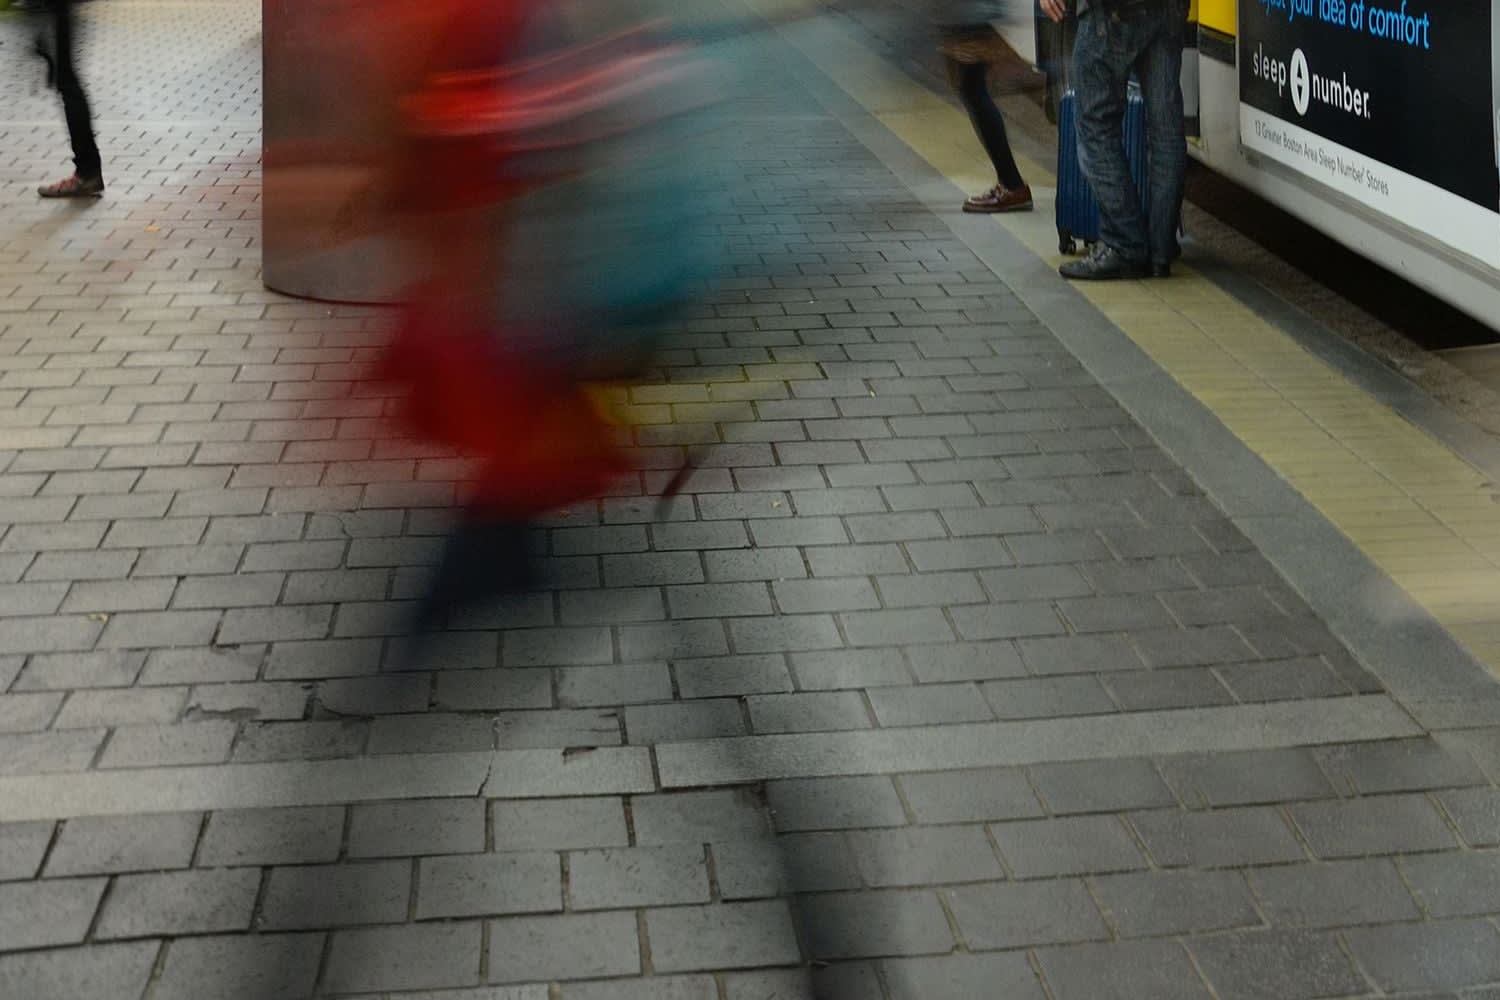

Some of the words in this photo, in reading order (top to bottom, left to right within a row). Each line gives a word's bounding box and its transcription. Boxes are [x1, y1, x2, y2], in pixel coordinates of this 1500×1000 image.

[1368, 0, 1430, 50] comfort
[1253, 43, 1287, 97] sleep
[1283, 131, 1303, 156] Boston
[1319, 147, 1336, 177] Sleep
[1366, 169, 1390, 197] Stores
